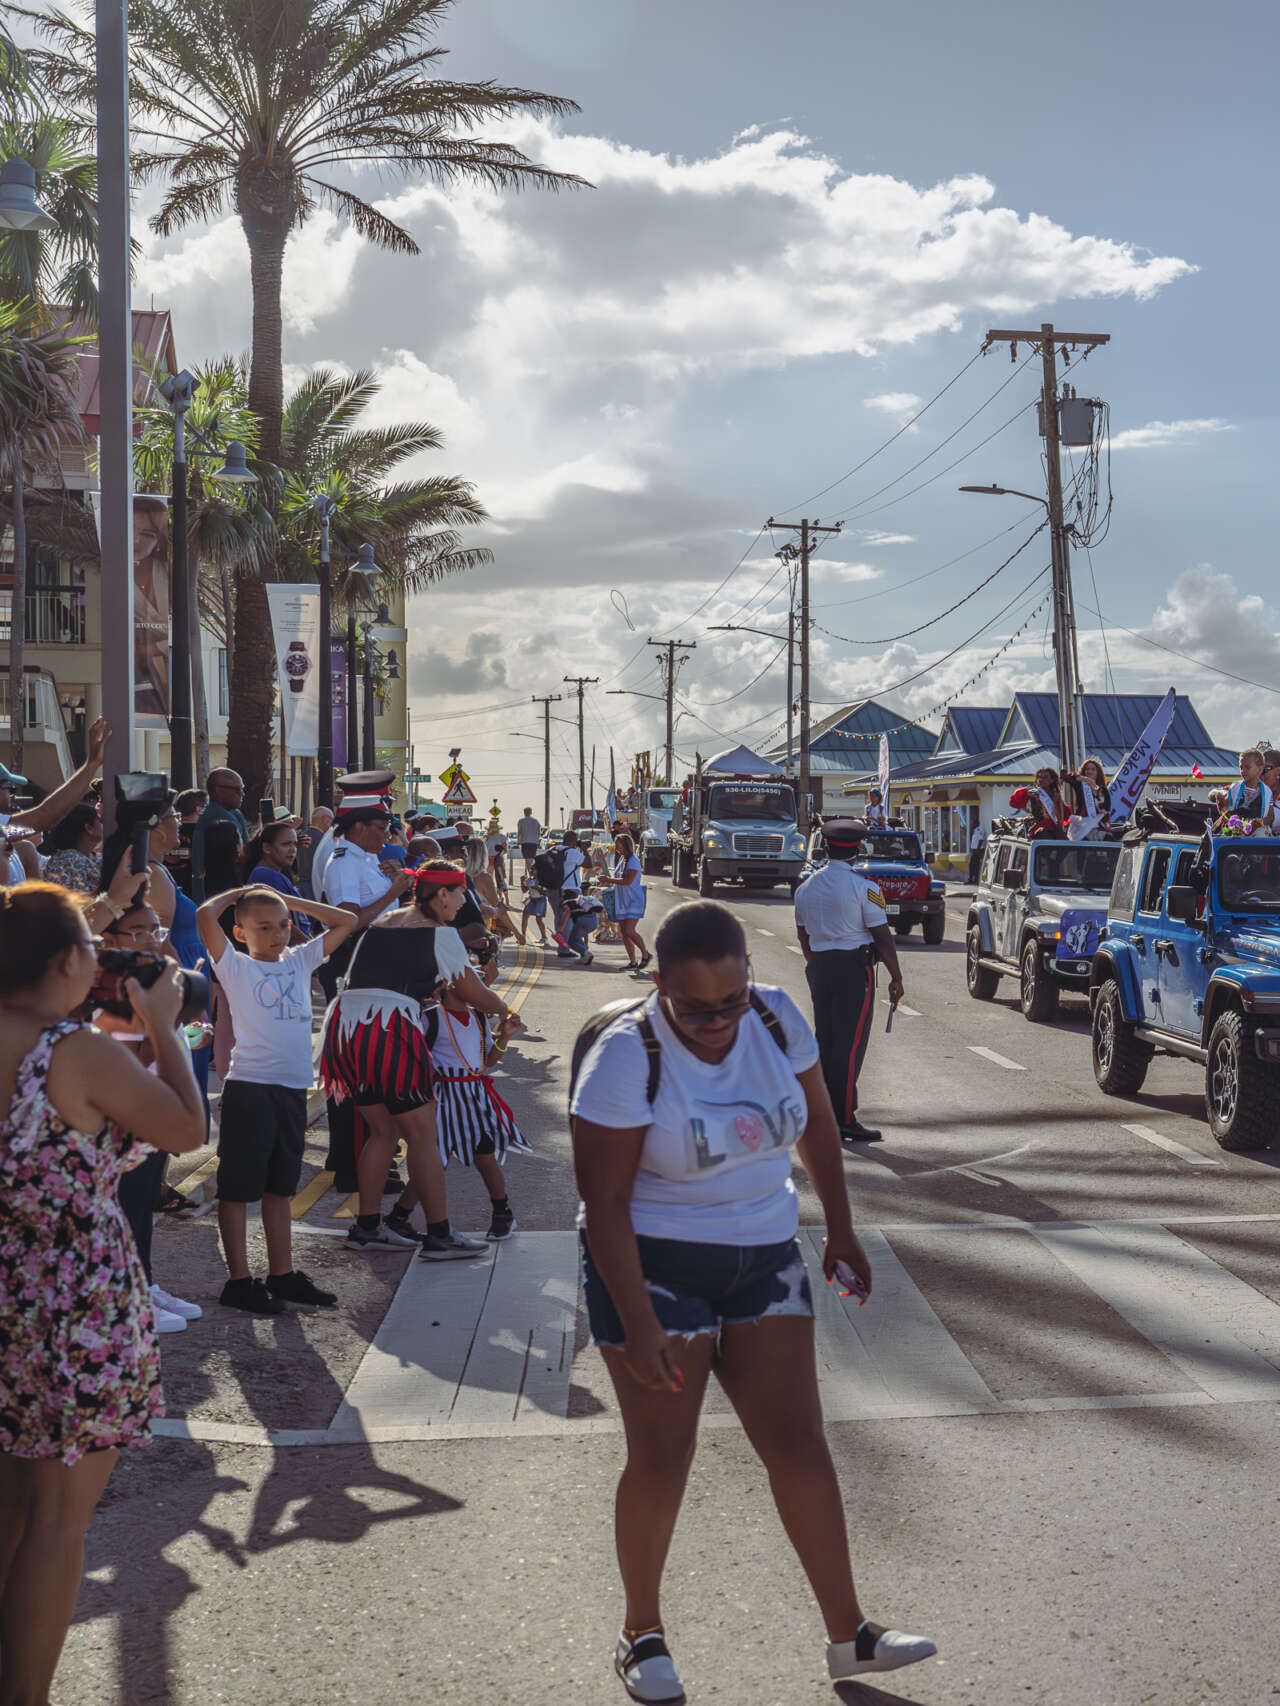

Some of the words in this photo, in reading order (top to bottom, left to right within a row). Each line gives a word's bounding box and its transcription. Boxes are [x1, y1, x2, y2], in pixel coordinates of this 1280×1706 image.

[1122, 740, 1151, 776] Make
[448, 807, 472, 815] AHEAD
[877, 880, 908, 889] Prepare
